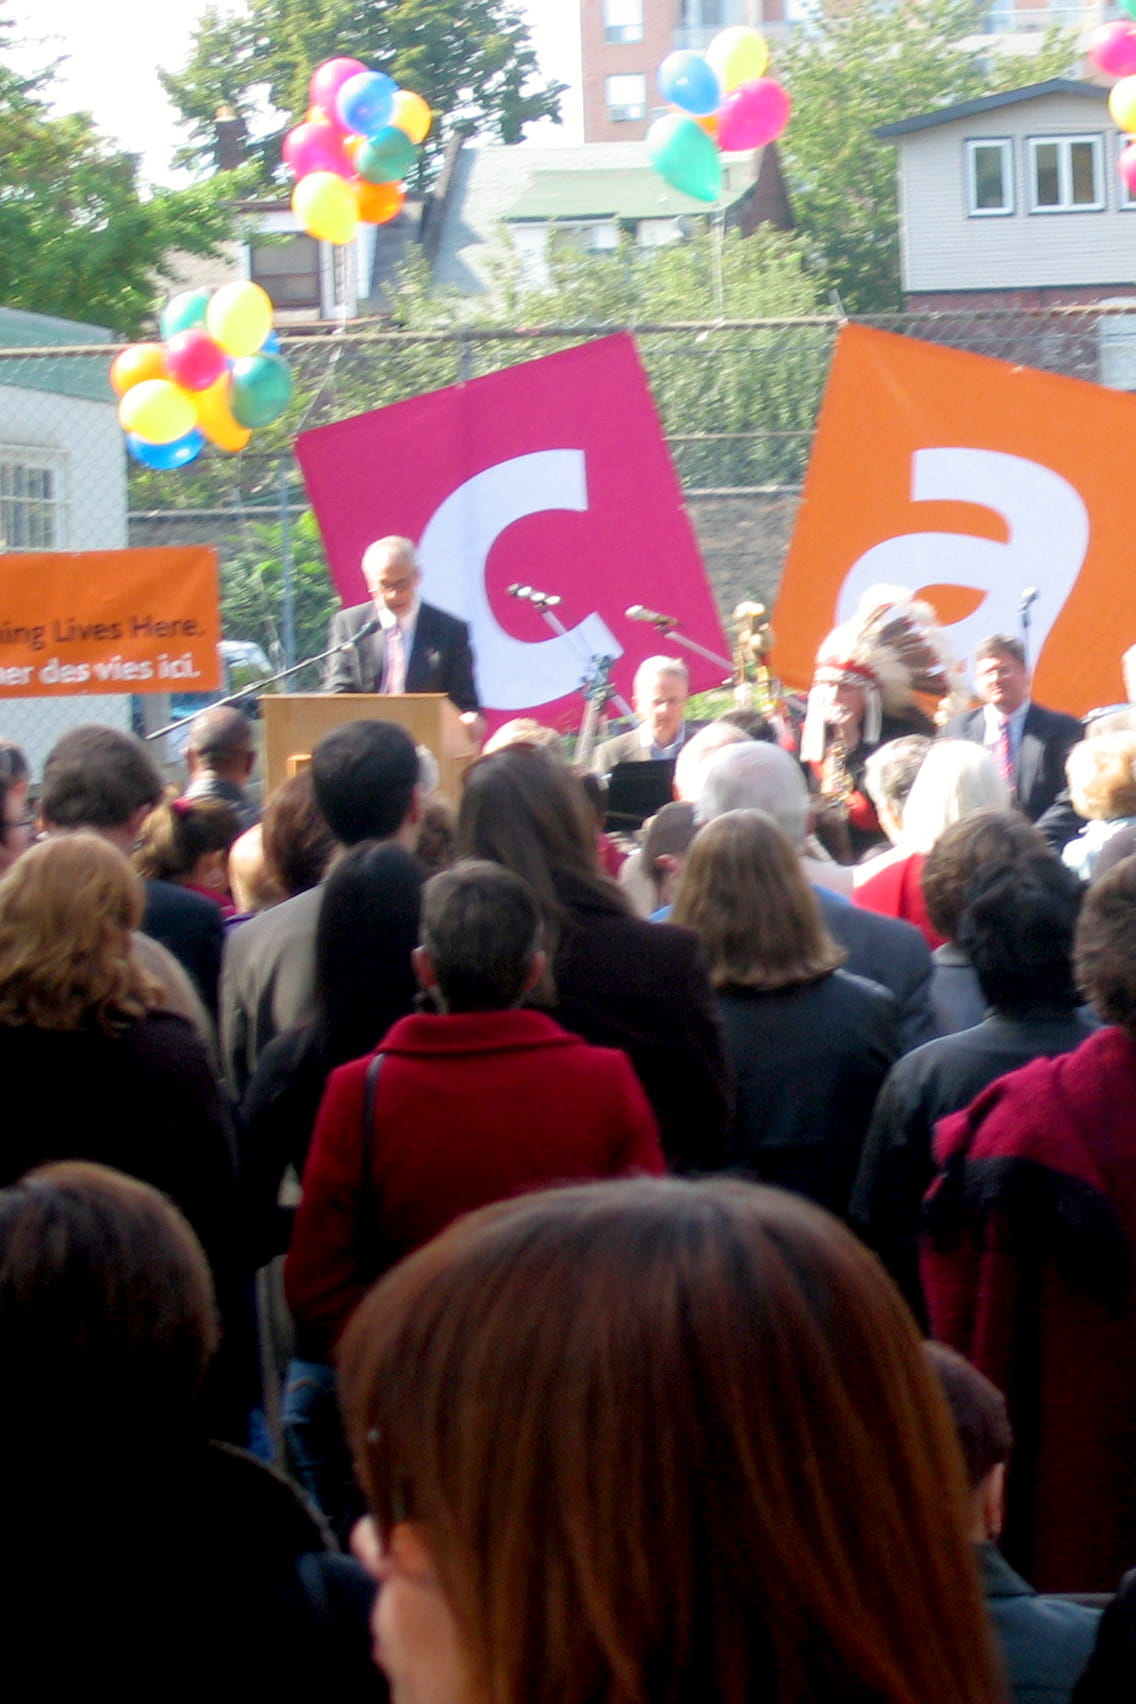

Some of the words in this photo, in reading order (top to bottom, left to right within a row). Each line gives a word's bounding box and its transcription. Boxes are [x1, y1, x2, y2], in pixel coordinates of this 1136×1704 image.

[54, 616, 122, 642] Lives
[130, 614, 206, 638] Here.
[38, 656, 91, 685] des
[93, 654, 154, 682] vies
[157, 652, 203, 679] ici.
